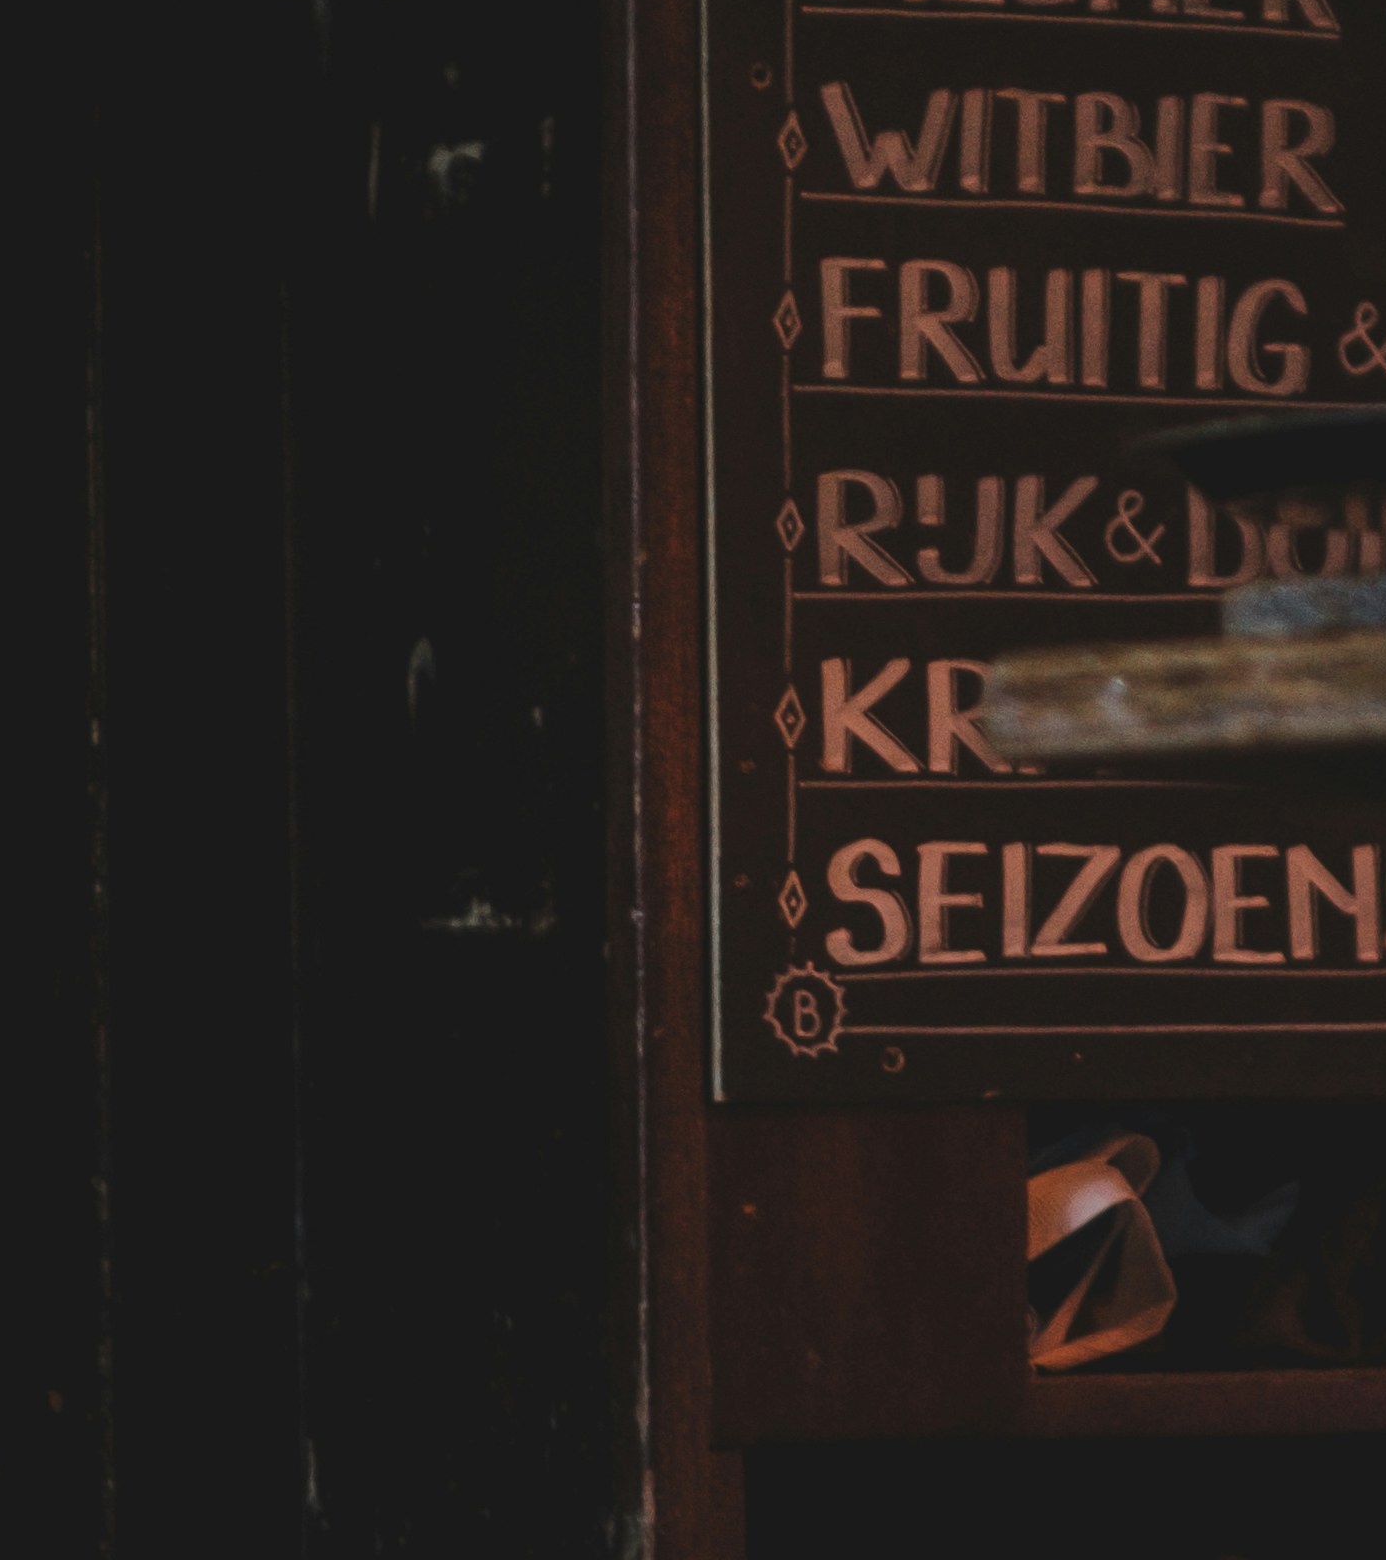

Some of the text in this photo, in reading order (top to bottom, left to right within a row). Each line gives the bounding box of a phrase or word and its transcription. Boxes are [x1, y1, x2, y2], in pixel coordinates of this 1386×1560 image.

[821, 82, 1344, 214] WITBIER
[819, 257, 1310, 392] FRUITIG
[1104, 489, 1167, 569] &
